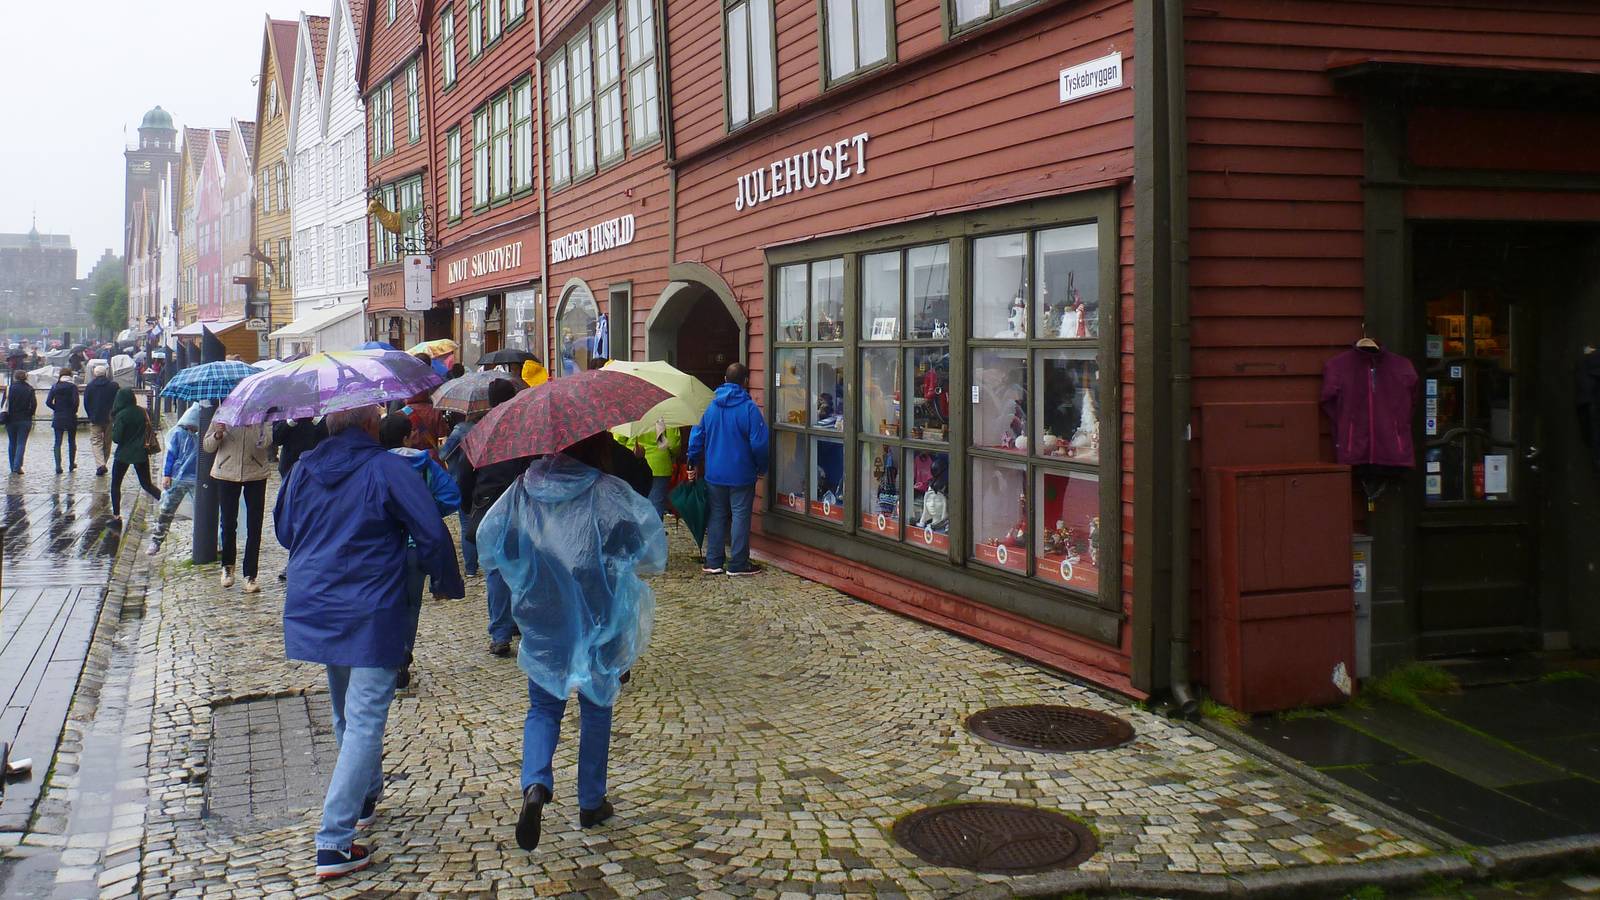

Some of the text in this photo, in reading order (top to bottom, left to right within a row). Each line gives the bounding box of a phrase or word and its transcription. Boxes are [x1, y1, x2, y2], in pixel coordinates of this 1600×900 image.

[1064, 64, 1118, 95] Tyskebryggen
[735, 132, 870, 212] JULEHUSET
[551, 214, 635, 263] BRYGGEN HUSFLID
[448, 258, 468, 284] KNUT
